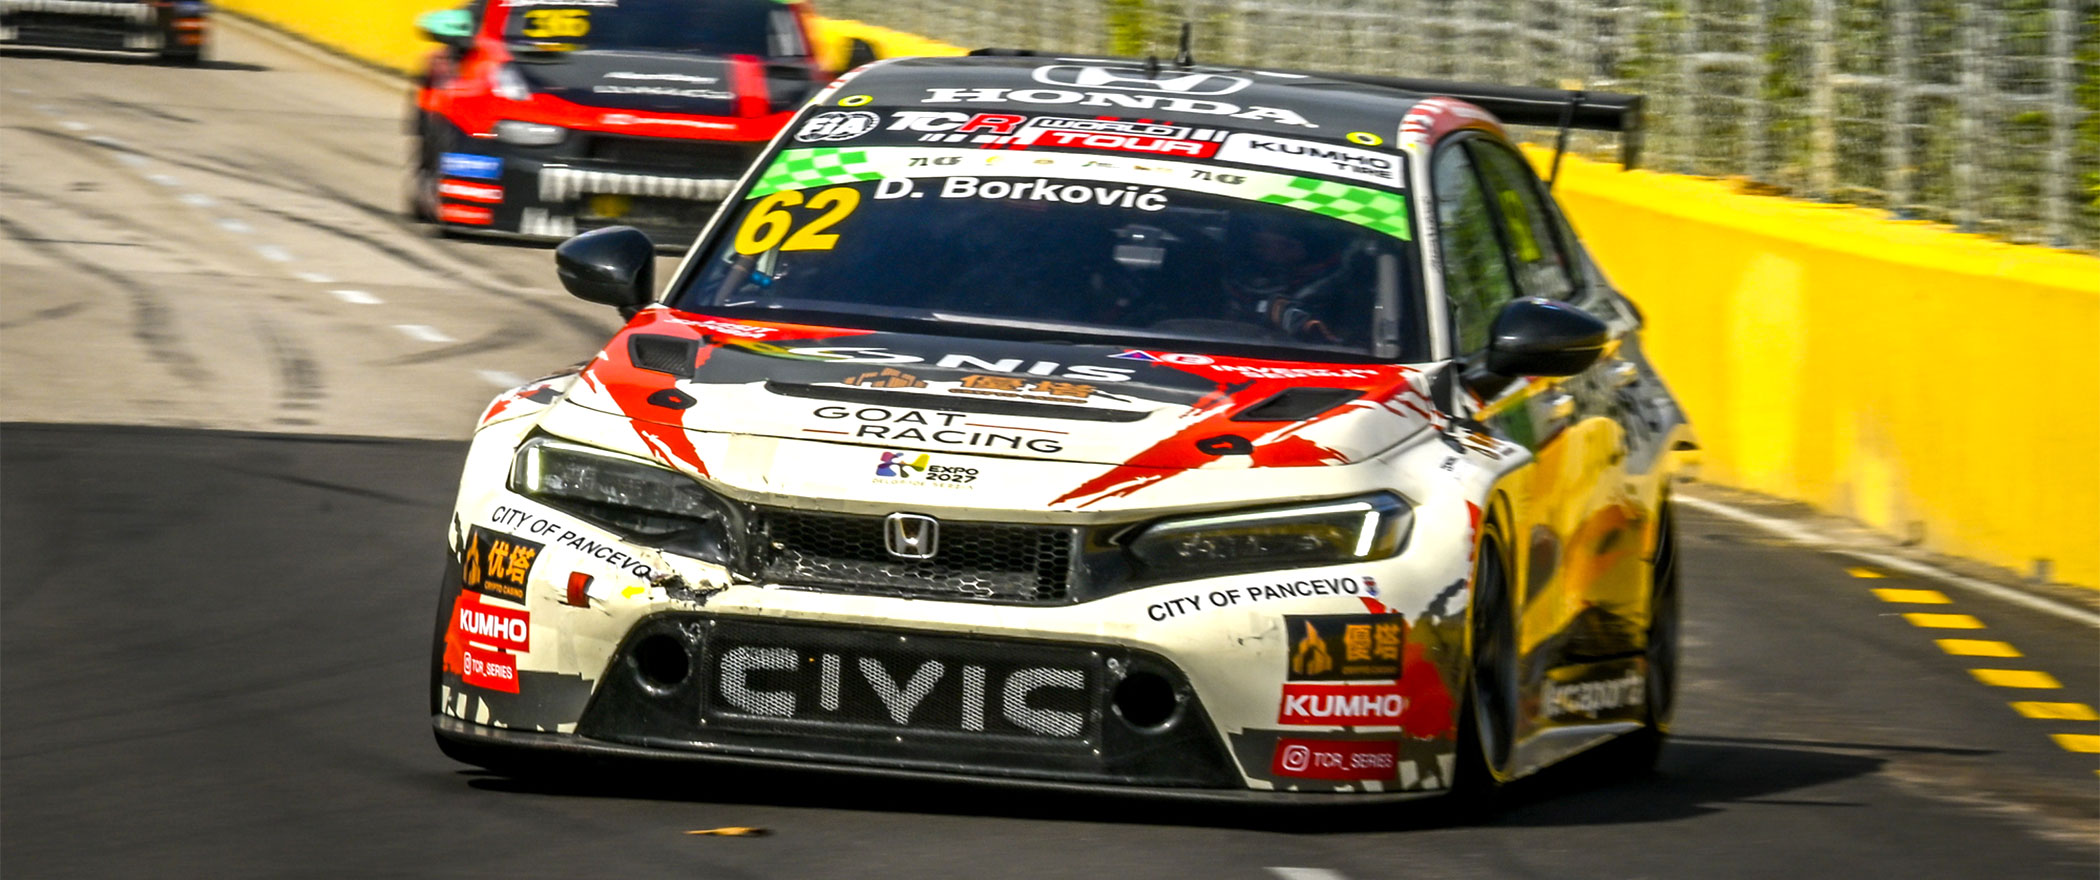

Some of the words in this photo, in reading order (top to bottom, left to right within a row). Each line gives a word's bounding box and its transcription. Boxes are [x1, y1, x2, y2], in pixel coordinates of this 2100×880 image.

[921, 87, 1320, 128] HONDA
[797, 113, 868, 140] FIA
[886, 111, 1027, 135] TCR
[1039, 119, 1175, 136] WORLD
[1051, 131, 1204, 155] TOUR
[1248, 139, 1392, 169] KUMHO
[1331, 161, 1394, 179] TIRE
[874, 177, 925, 200] D.
[941, 176, 1169, 212] Borković
[734, 187, 861, 255] 62
[936, 353, 1137, 382] NIS
[813, 406, 967, 427] GOAT
[856, 425, 1064, 453] RACING
[926, 473, 977, 483] 2027
[928, 465, 979, 475] EXPO
[491, 506, 532, 529] CITY
[530, 519, 560, 537] OF
[488, 540, 536, 585] 优塔
[1147, 594, 1203, 622] CITY
[1208, 589, 1242, 607] OF
[1247, 577, 1360, 601] PANCEVO
[459, 609, 528, 642] KUMHO
[471, 658, 513, 680] TCR_SERIES
[720, 646, 1085, 737] CIVIC
[1283, 694, 1404, 717] KUMHO
[1312, 752, 1394, 771] TCR_SERIES
